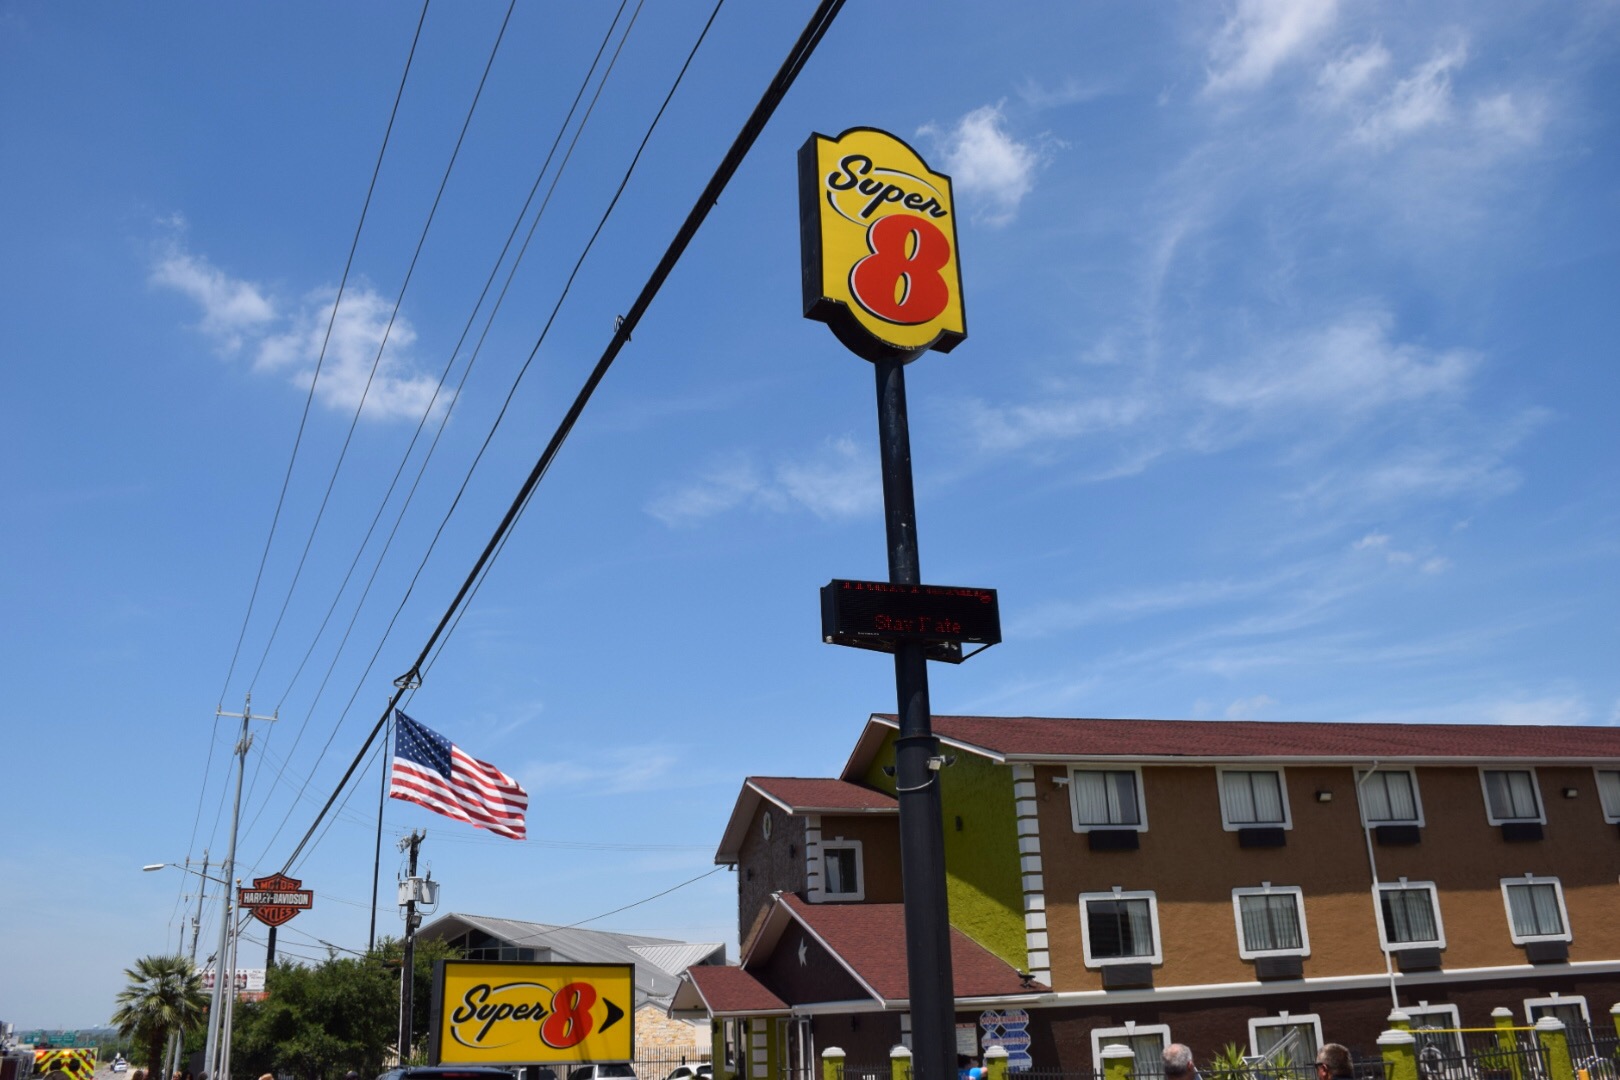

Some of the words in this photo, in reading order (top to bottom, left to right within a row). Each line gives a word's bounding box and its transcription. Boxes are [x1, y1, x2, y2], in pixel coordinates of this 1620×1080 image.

[826, 154, 948, 219] Super
[847, 213, 951, 326] 8
[243, 892, 309, 905] HARLEY-DAVIDSON
[260, 879, 294, 890] MOTOR
[259, 907, 292, 921] CYCLES
[452, 983, 549, 1043] Super
[540, 982, 597, 1049] 8
